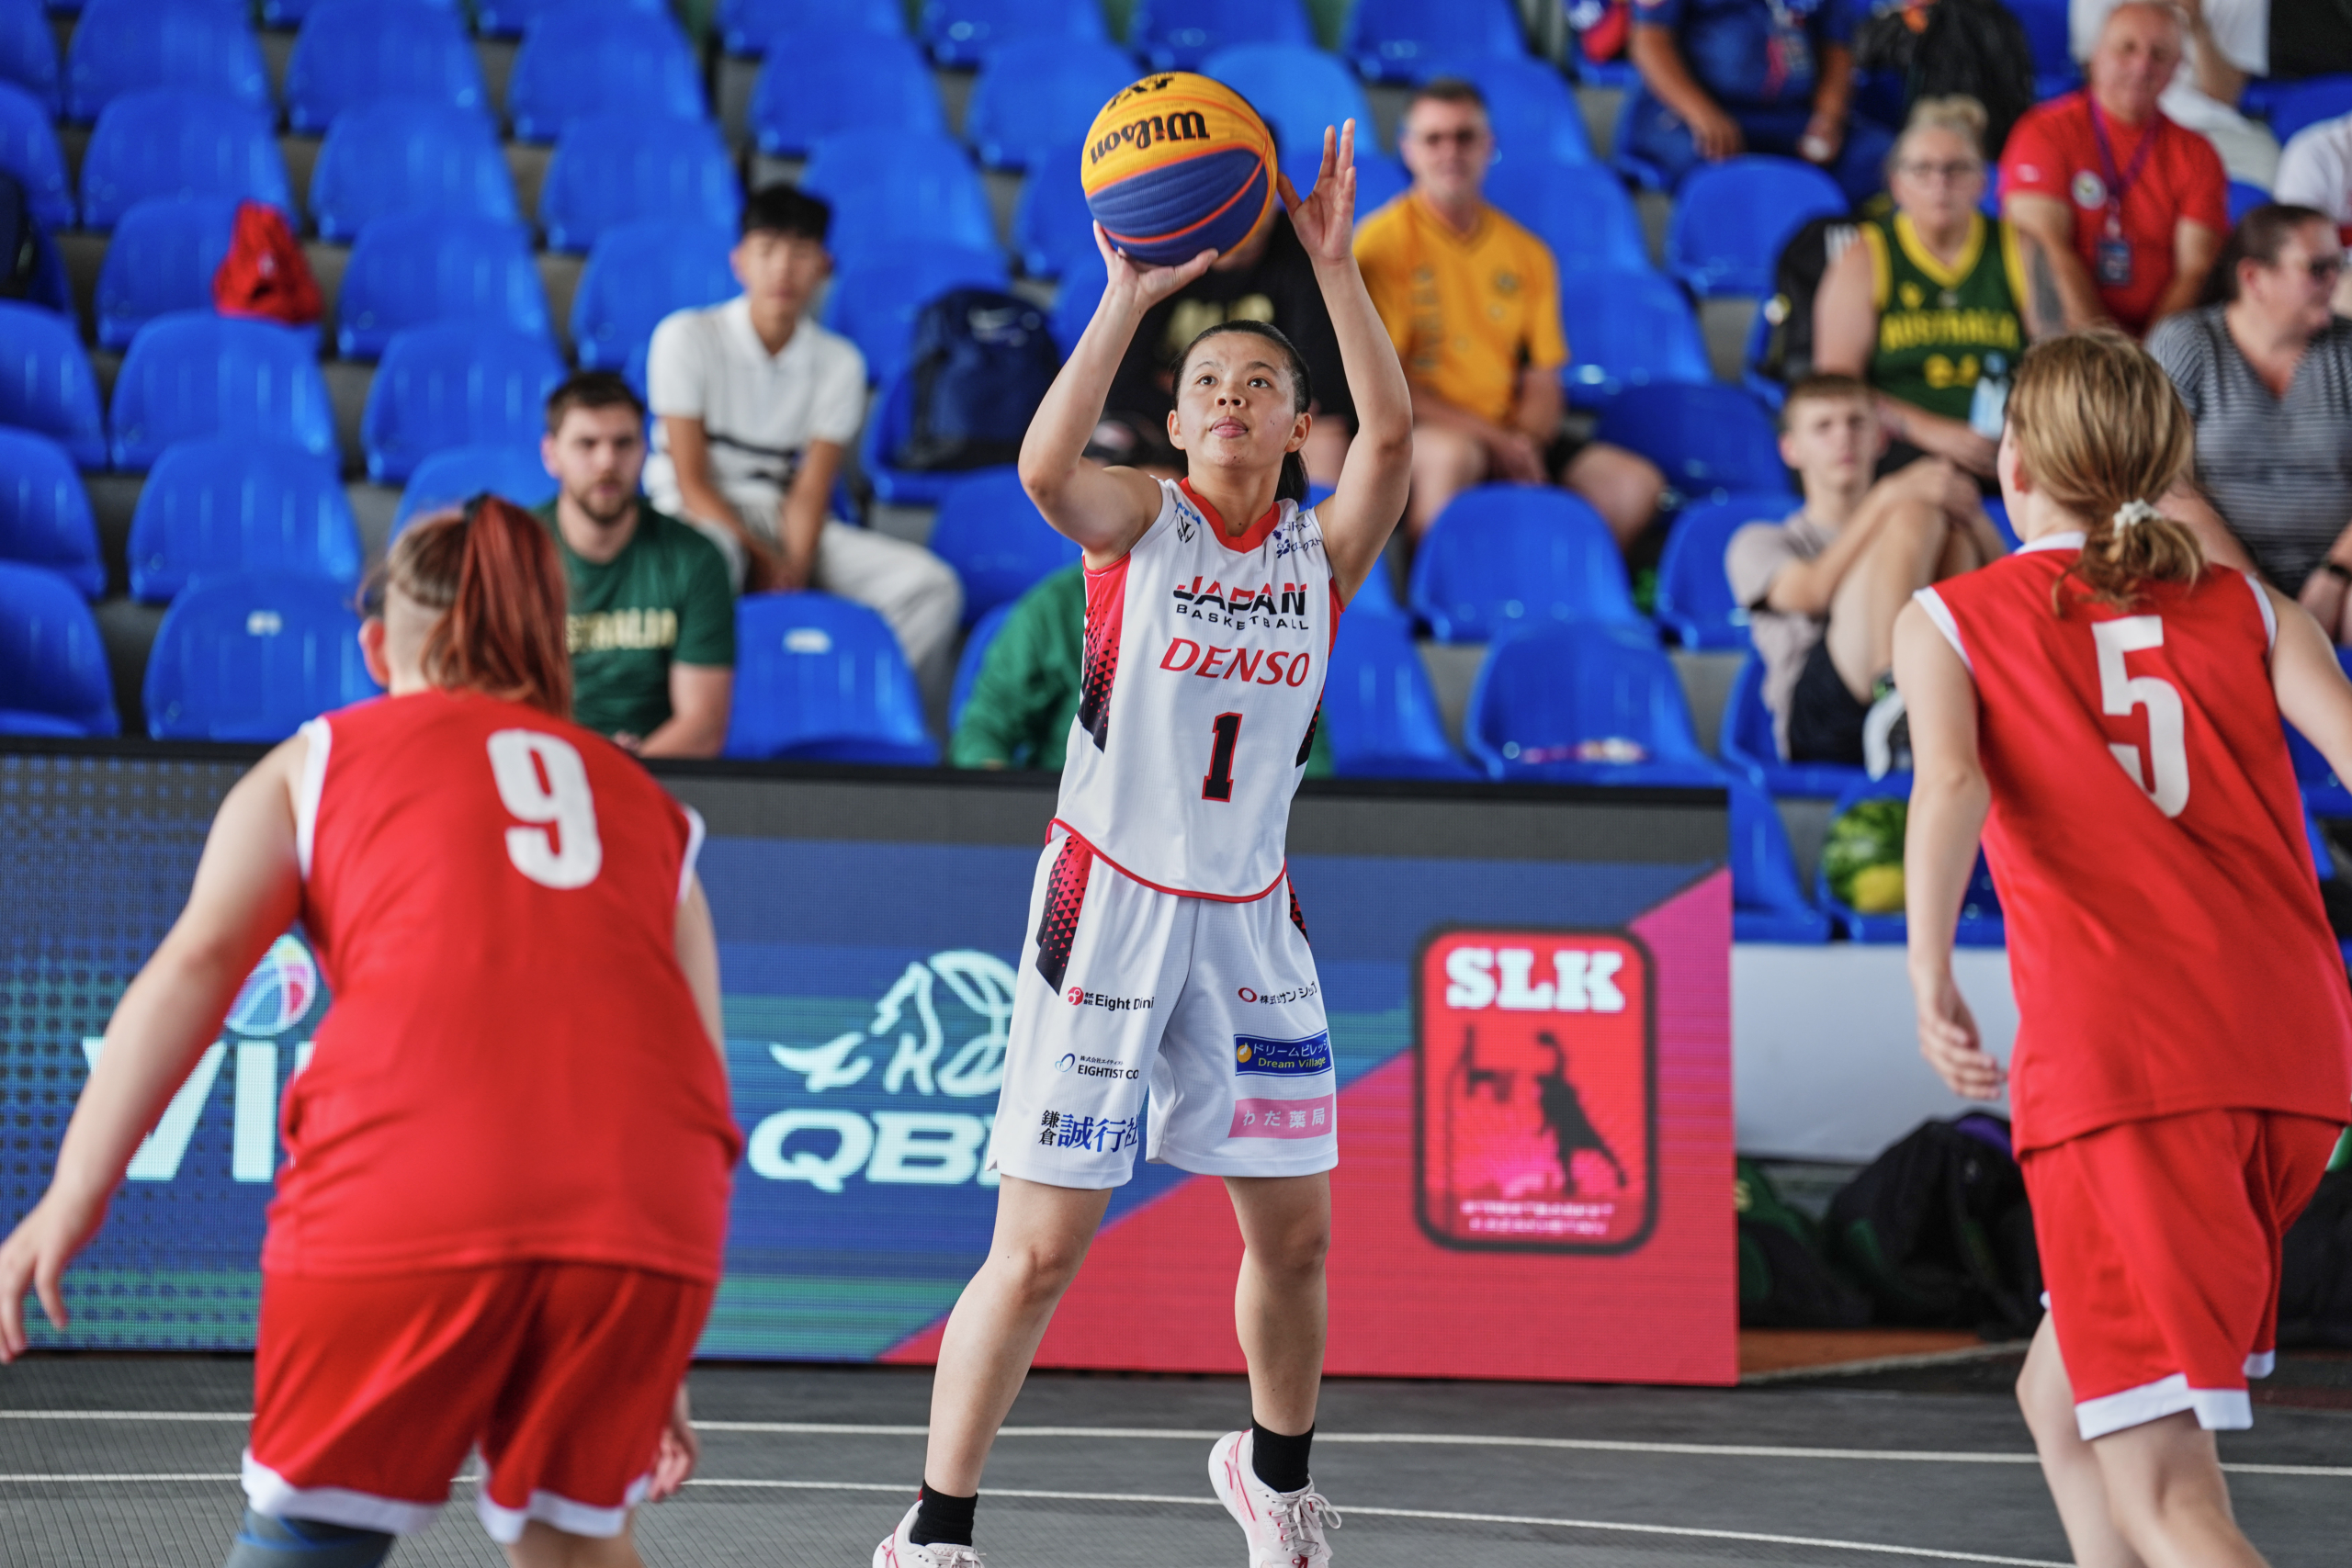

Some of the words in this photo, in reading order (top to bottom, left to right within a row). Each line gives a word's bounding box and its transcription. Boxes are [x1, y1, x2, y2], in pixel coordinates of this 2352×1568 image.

[1090, 111, 1211, 164] Wilson
[1173, 576, 1307, 616] JAPAN
[1176, 604, 1309, 631] BASKETBALL
[1159, 637, 1310, 688] DENSO
[2091, 615, 2190, 818] 5
[1202, 711, 1243, 804] 1
[486, 728, 604, 891] 9
[1445, 947, 1625, 1013] SLK
[1095, 994, 1130, 1011] Eight
[1078, 1065, 1124, 1078] EIGHTIST
[1258, 1057, 1295, 1068] Dream
[1298, 1056, 1326, 1068] Village
[1038, 1110, 1060, 1146] 鎌倉
[1057, 1113, 1138, 1153] 誠行社
[1243, 1107, 1326, 1129] わだ薬局
[748, 1108, 1001, 1194] QB
